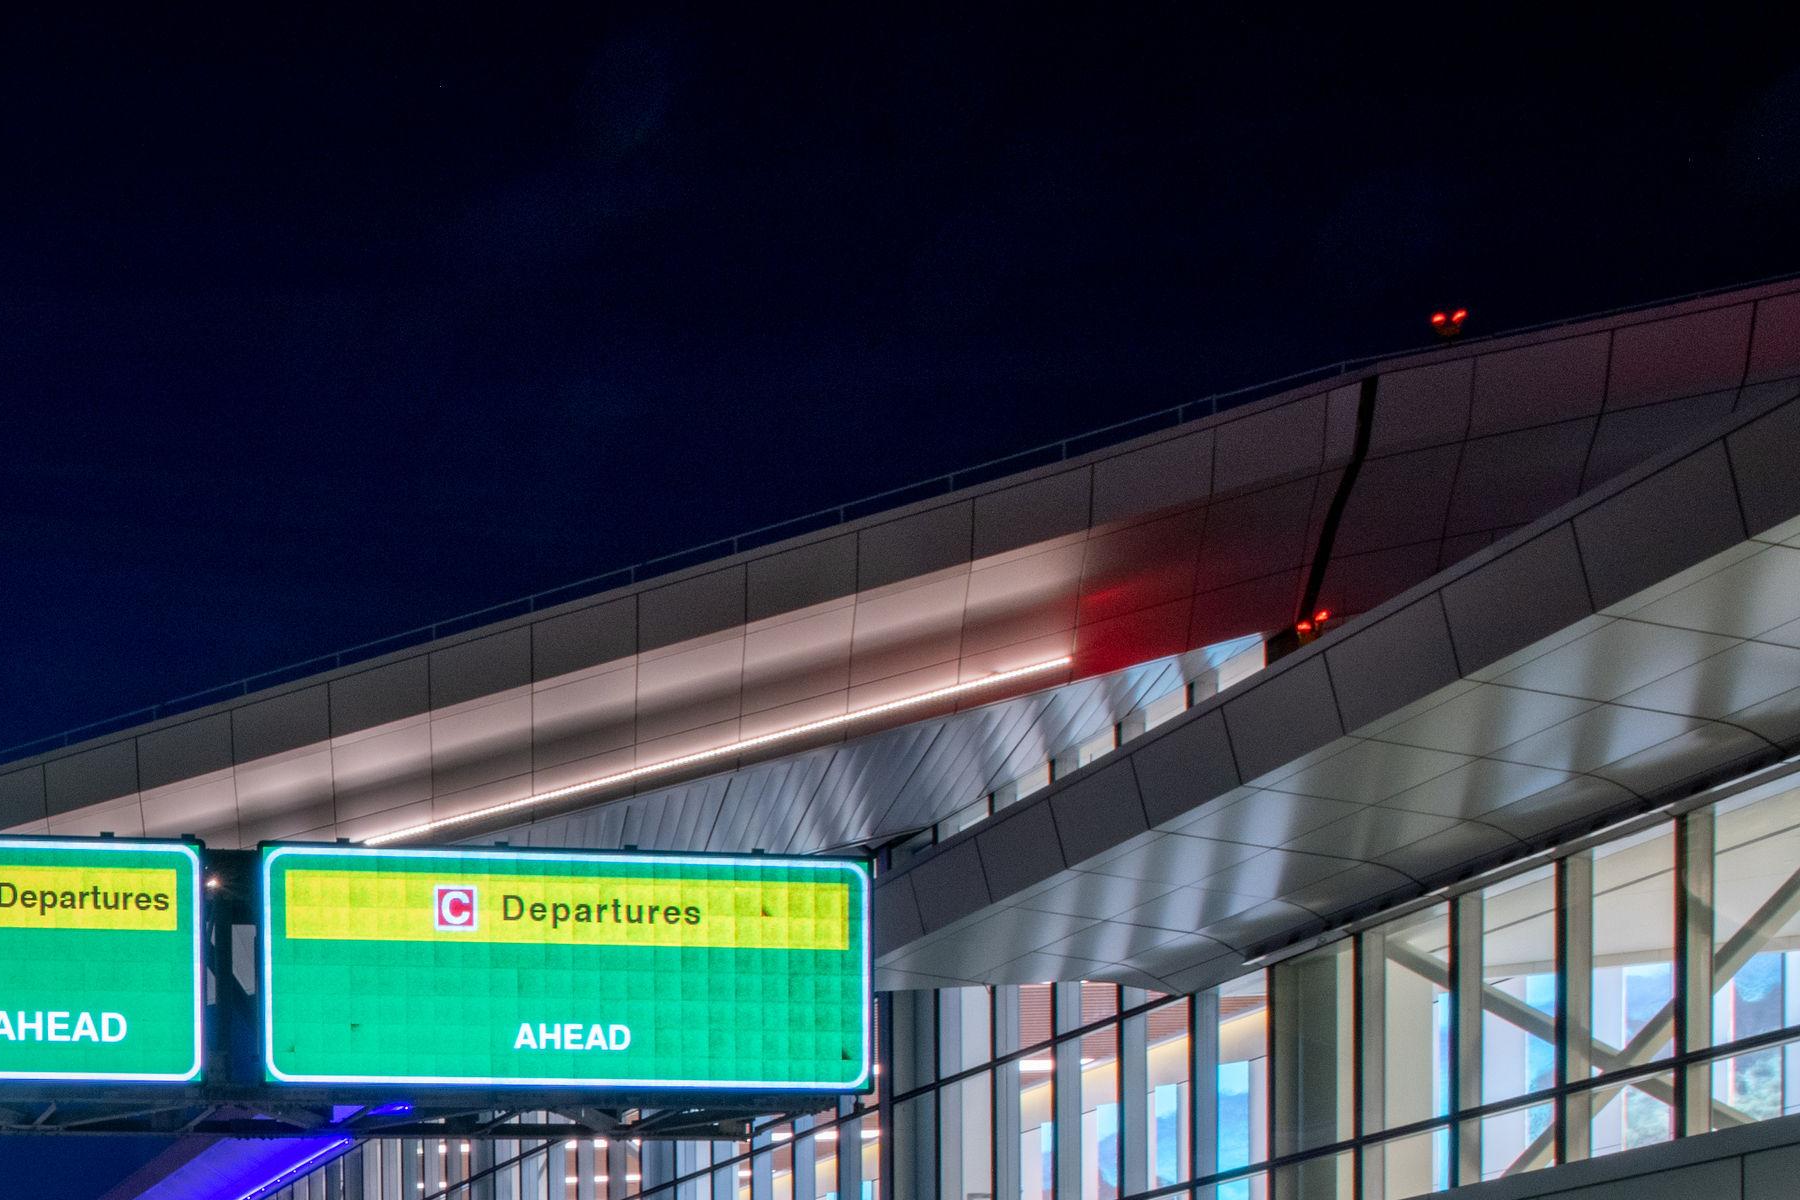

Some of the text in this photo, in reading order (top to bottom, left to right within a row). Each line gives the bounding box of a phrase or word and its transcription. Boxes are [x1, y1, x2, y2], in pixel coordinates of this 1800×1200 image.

[440, 890, 702, 928] C Departures
[513, 1022, 632, 1051] AHEAD
